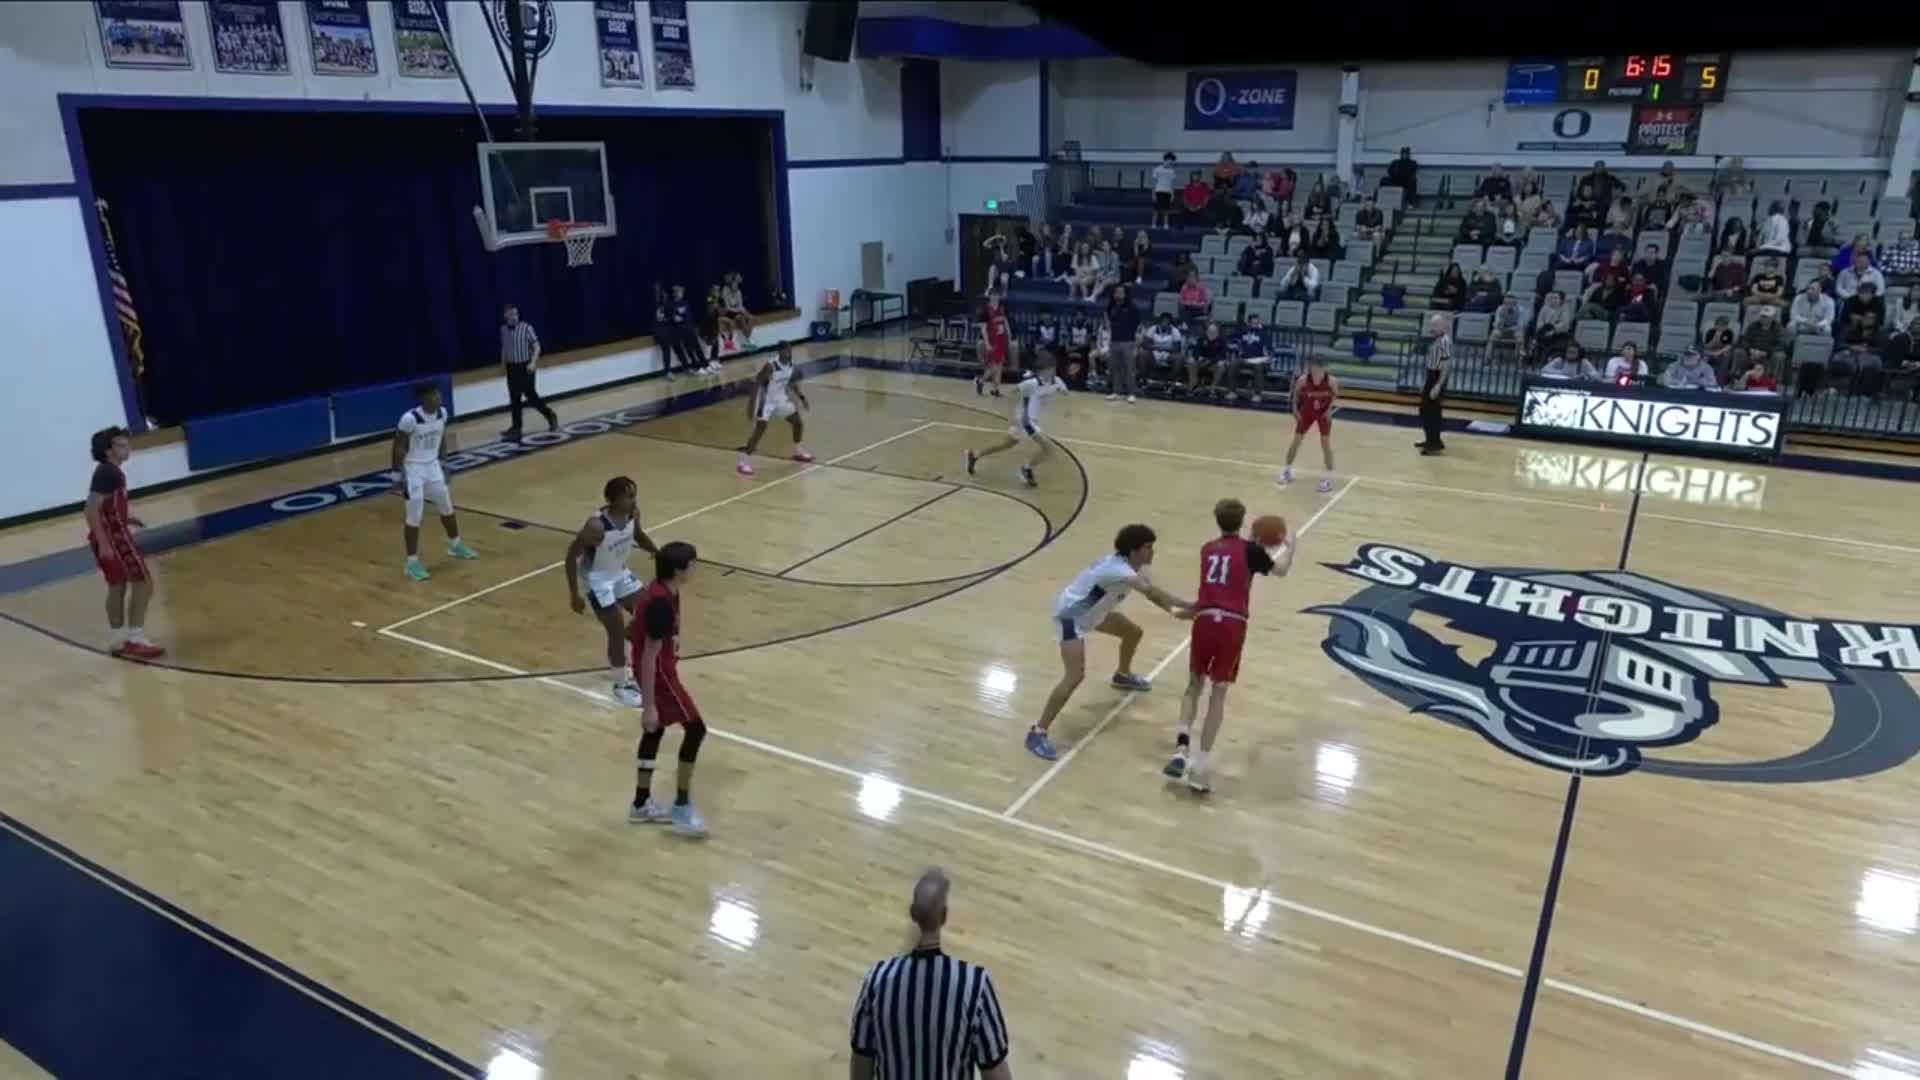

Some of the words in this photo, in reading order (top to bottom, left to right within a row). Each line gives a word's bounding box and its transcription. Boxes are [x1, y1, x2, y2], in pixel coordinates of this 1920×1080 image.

[1584, 69, 1600, 90] 0
[1626, 55, 1672, 77] 6:15
[1701, 66, 1717, 89] 5
[1652, 82, 1661, 101] 1
[1578, 396, 1775, 447] KNIGHTS
[271, 411, 648, 512] OABROOK
[1205, 553, 1232, 585] 21
[1357, 544, 1920, 669] KNIGHTS
